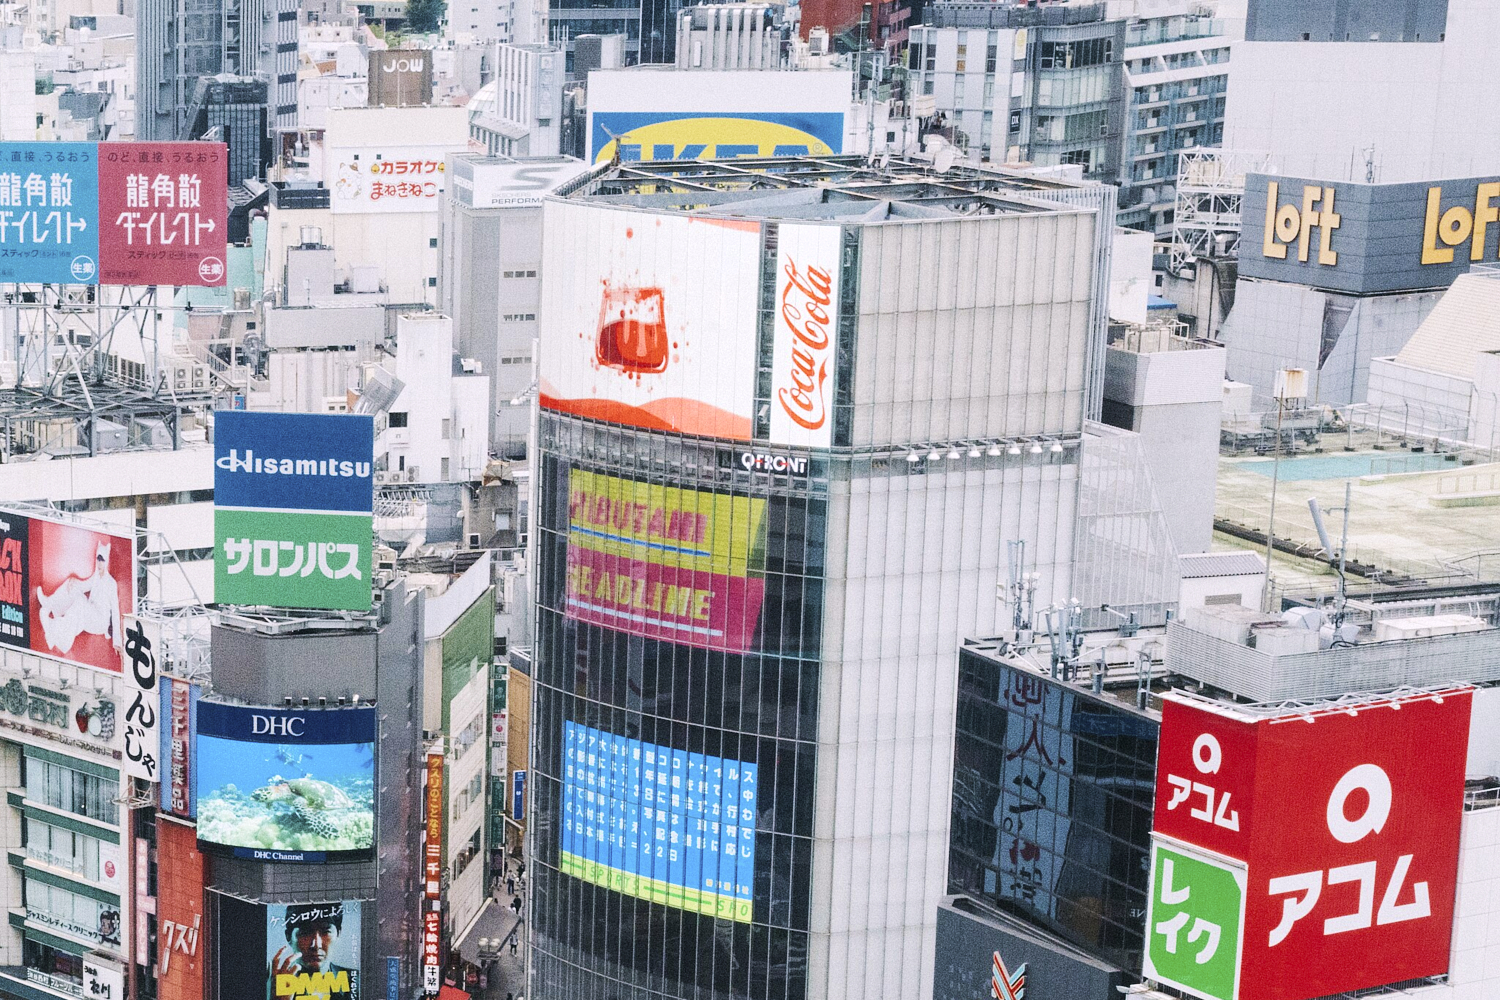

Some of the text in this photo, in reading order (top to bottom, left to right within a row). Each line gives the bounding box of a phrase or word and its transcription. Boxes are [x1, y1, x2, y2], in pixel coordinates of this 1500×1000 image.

[382, 58, 424, 73] JOW
[107, 151, 219, 163] のど、直接、うるおう
[380, 161, 438, 175] カラオケ
[0, 172, 73, 207] 龍角散
[126, 173, 201, 208] 龍角散
[370, 181, 437, 199] まねきねこ
[1263, 181, 1341, 266] Loft
[1421, 182, 1500, 265] LoF
[216, 449, 370, 477] Hisamitsu
[741, 452, 808, 473] QFRONT
[224, 538, 361, 580] サロンパス
[125, 620, 156, 777] もんじゃ
[252, 714, 305, 737] DHC
[1167, 774, 1240, 832] アコム
[254, 851, 304, 861] DHC Channel
[270, 901, 360, 928] ケンシロウによろしく
[1155, 858, 1222, 965] レイク
[1268, 854, 1432, 948] アコム
[276, 971, 350, 996] DMM
